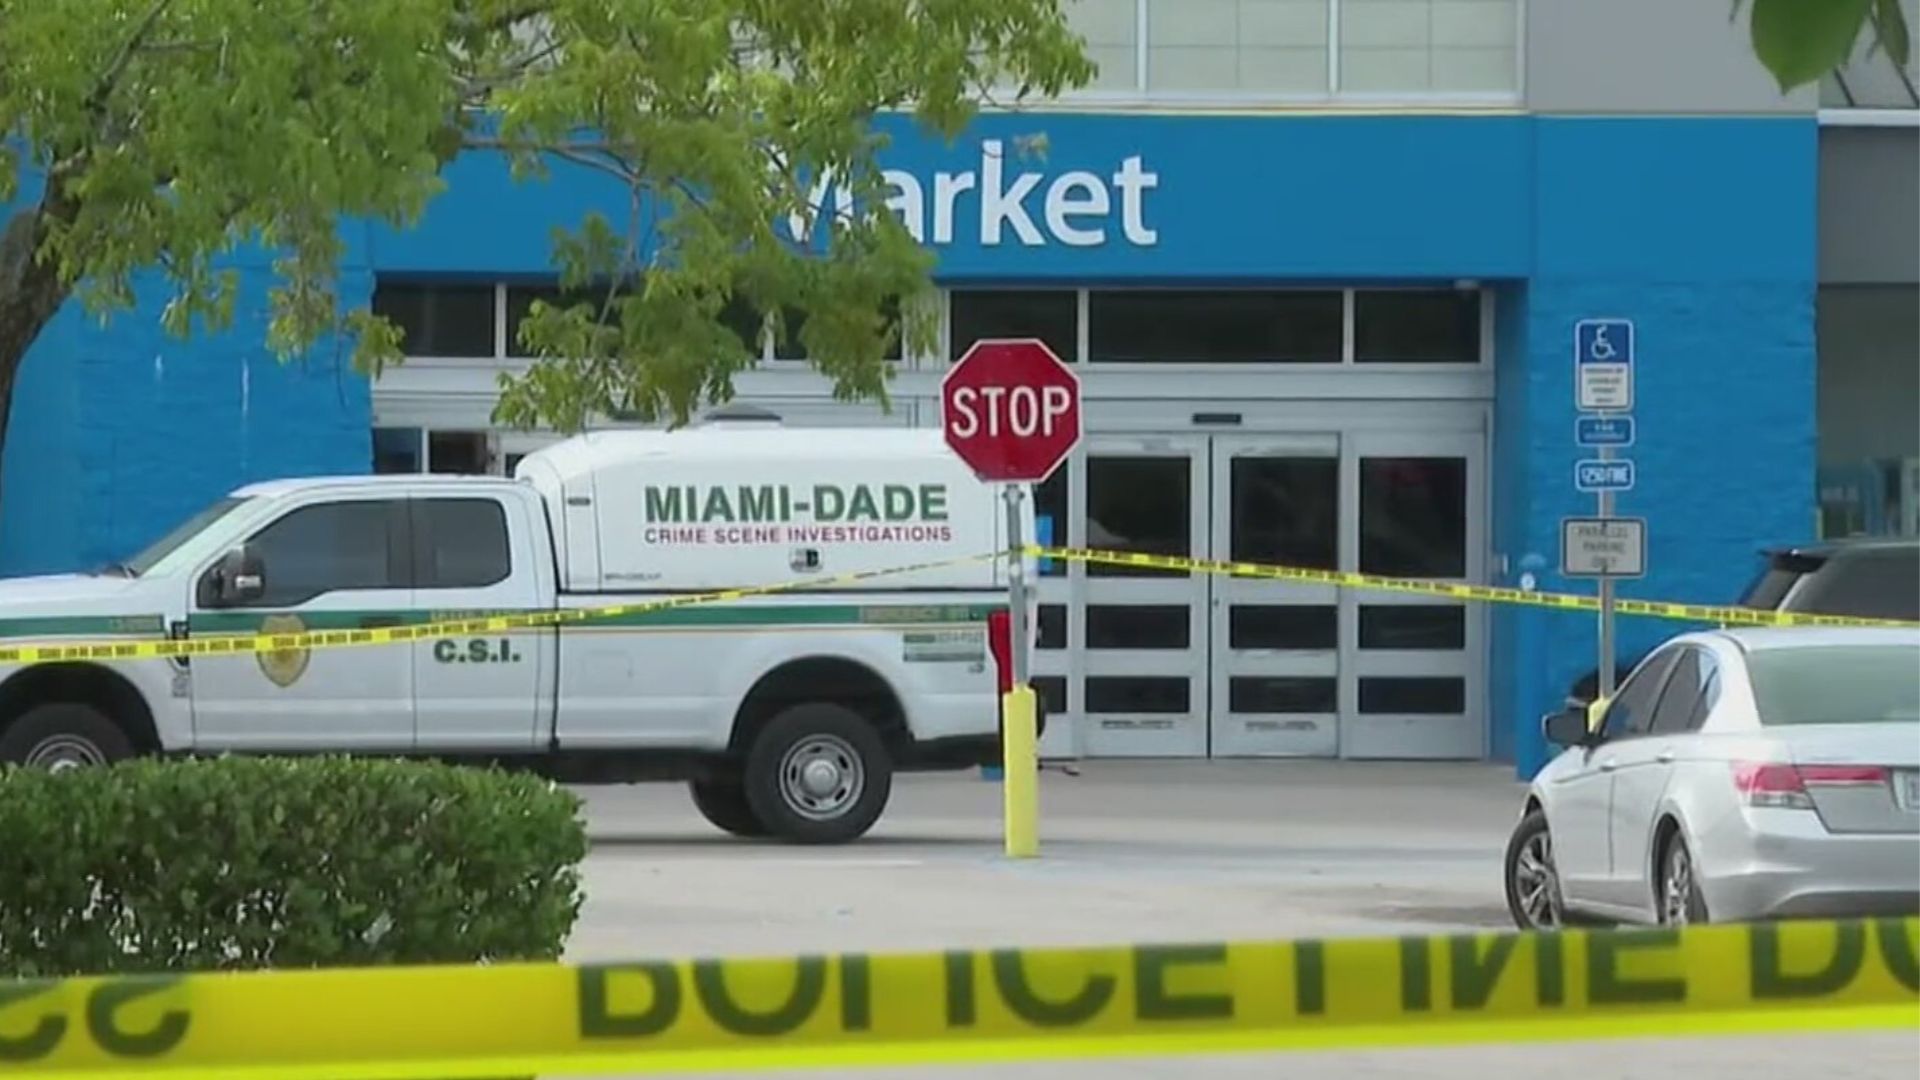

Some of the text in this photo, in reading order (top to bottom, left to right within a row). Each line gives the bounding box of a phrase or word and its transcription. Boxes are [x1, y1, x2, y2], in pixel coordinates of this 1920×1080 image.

[951, 386, 1071, 438] STOP
[644, 484, 951, 523] MIAMI-DADE
[644, 526, 952, 544] CRIME SCENE INVESTIGATIONS
[433, 638, 521, 662] C.S.I.
